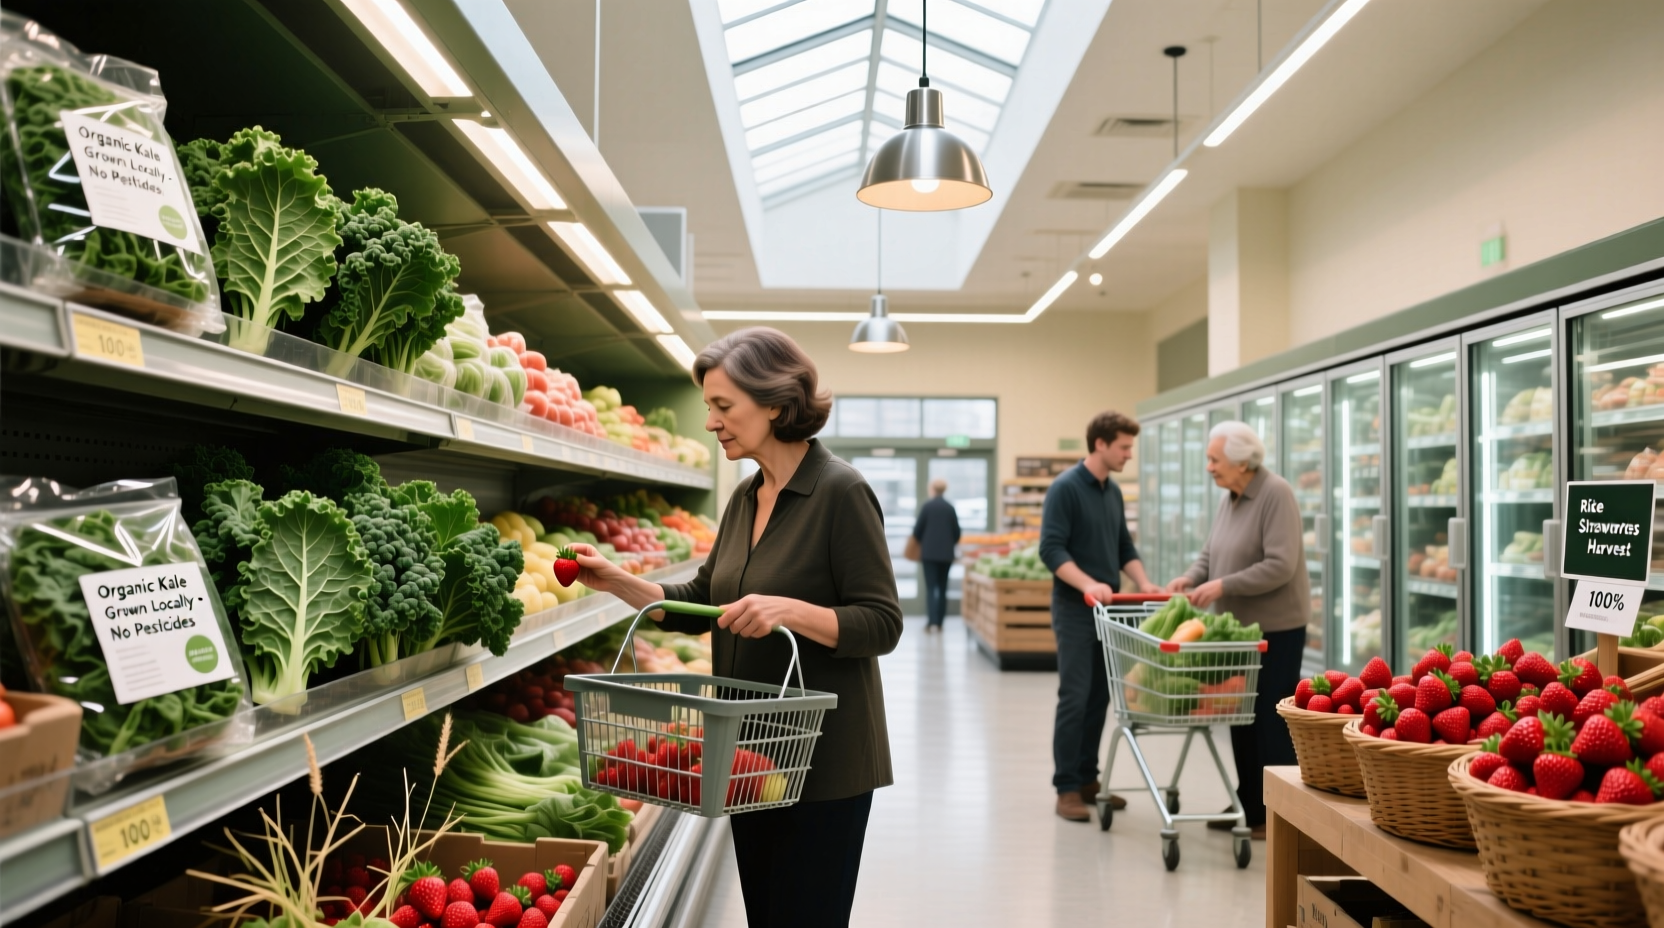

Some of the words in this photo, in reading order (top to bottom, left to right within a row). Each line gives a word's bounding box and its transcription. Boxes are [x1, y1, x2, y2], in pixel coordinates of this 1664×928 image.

[78, 126, 132, 152] Organic
[134, 142, 161, 162] Kale
[88, 164, 108, 180] No
[98, 334, 125, 357] 100
[97, 578, 155, 601] Organic
[157, 574, 187, 591] Kale
[151, 593, 194, 612] Locally
[1589, 590, 1625, 611] 100%
[110, 626, 131, 642] No
[119, 818, 150, 849] 100
